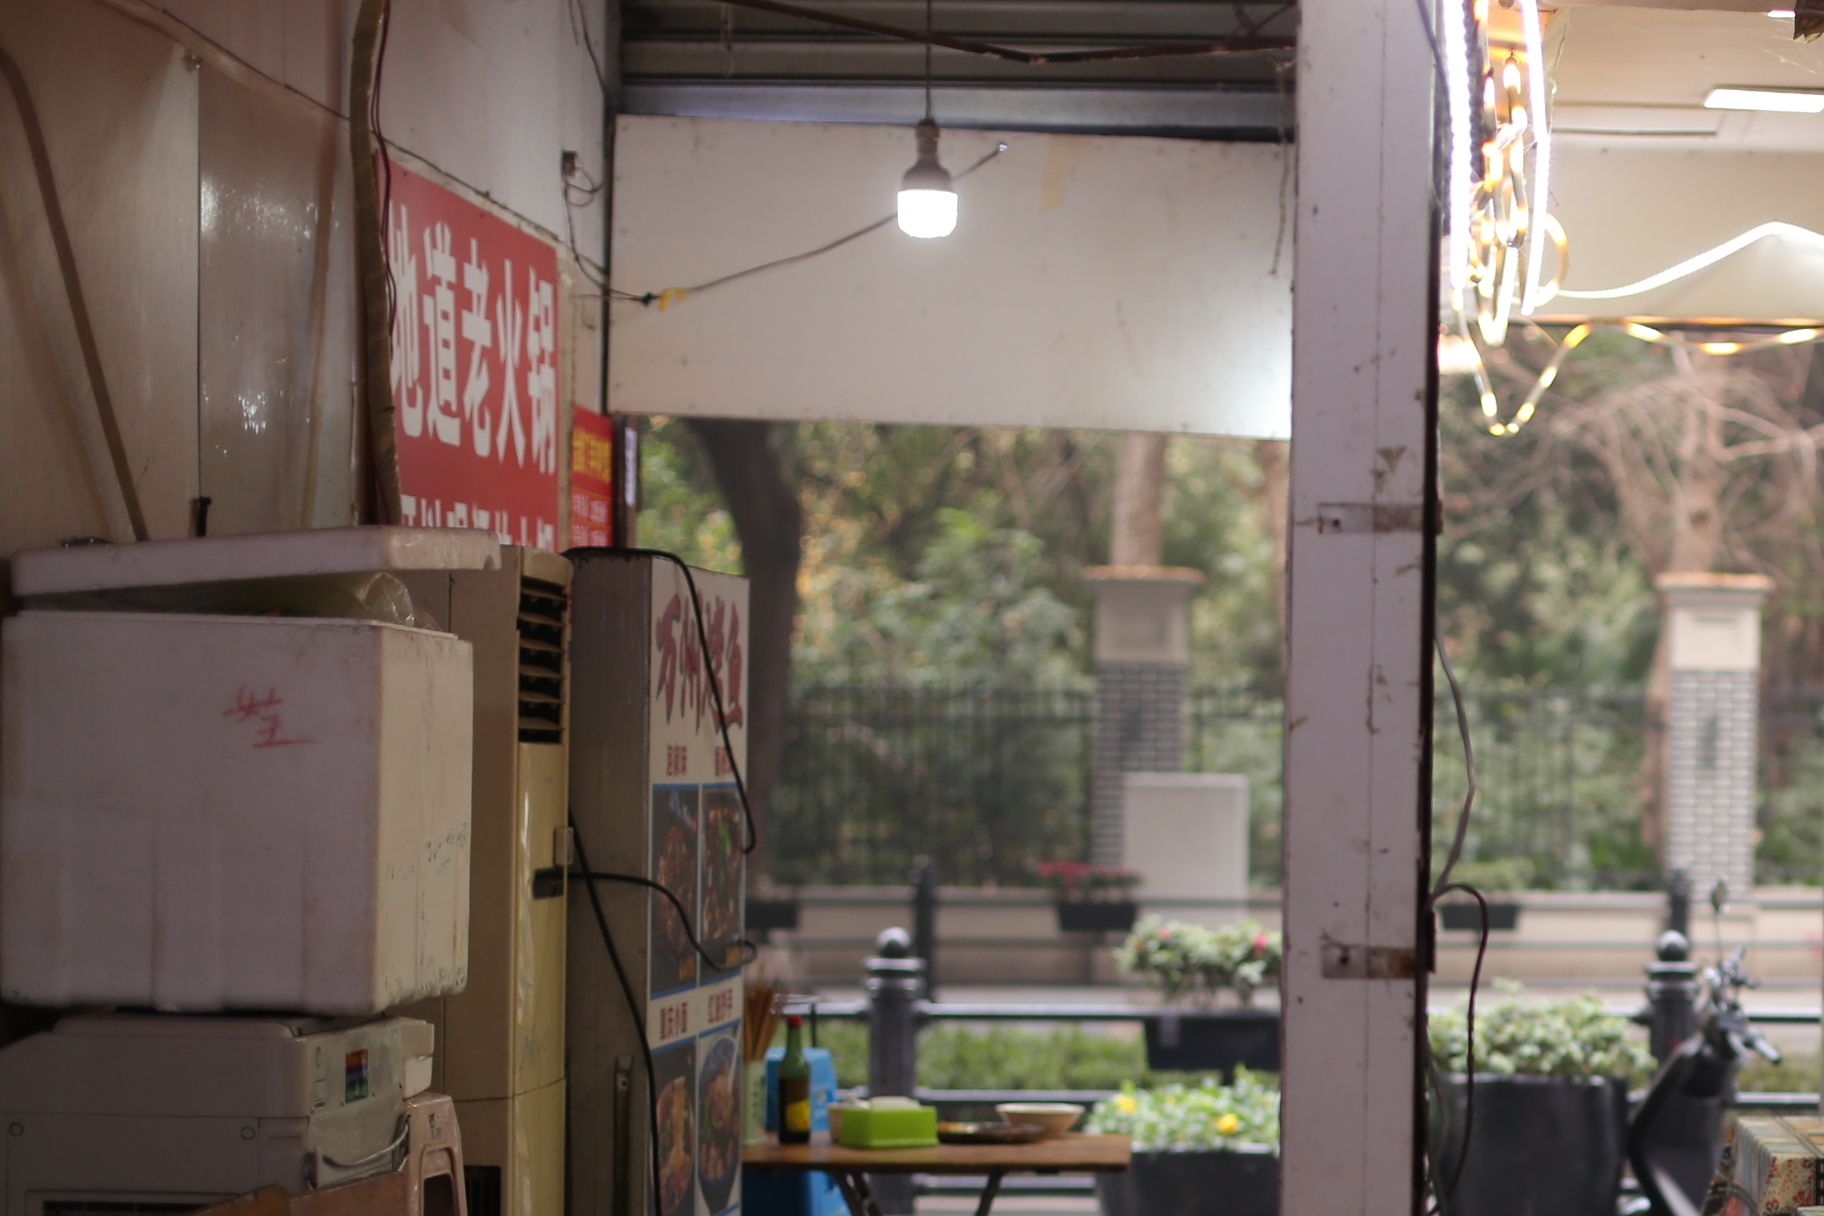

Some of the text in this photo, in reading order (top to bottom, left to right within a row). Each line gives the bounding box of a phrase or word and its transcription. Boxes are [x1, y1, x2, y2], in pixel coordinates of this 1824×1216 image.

[389, 201, 556, 476] 地道老火锅
